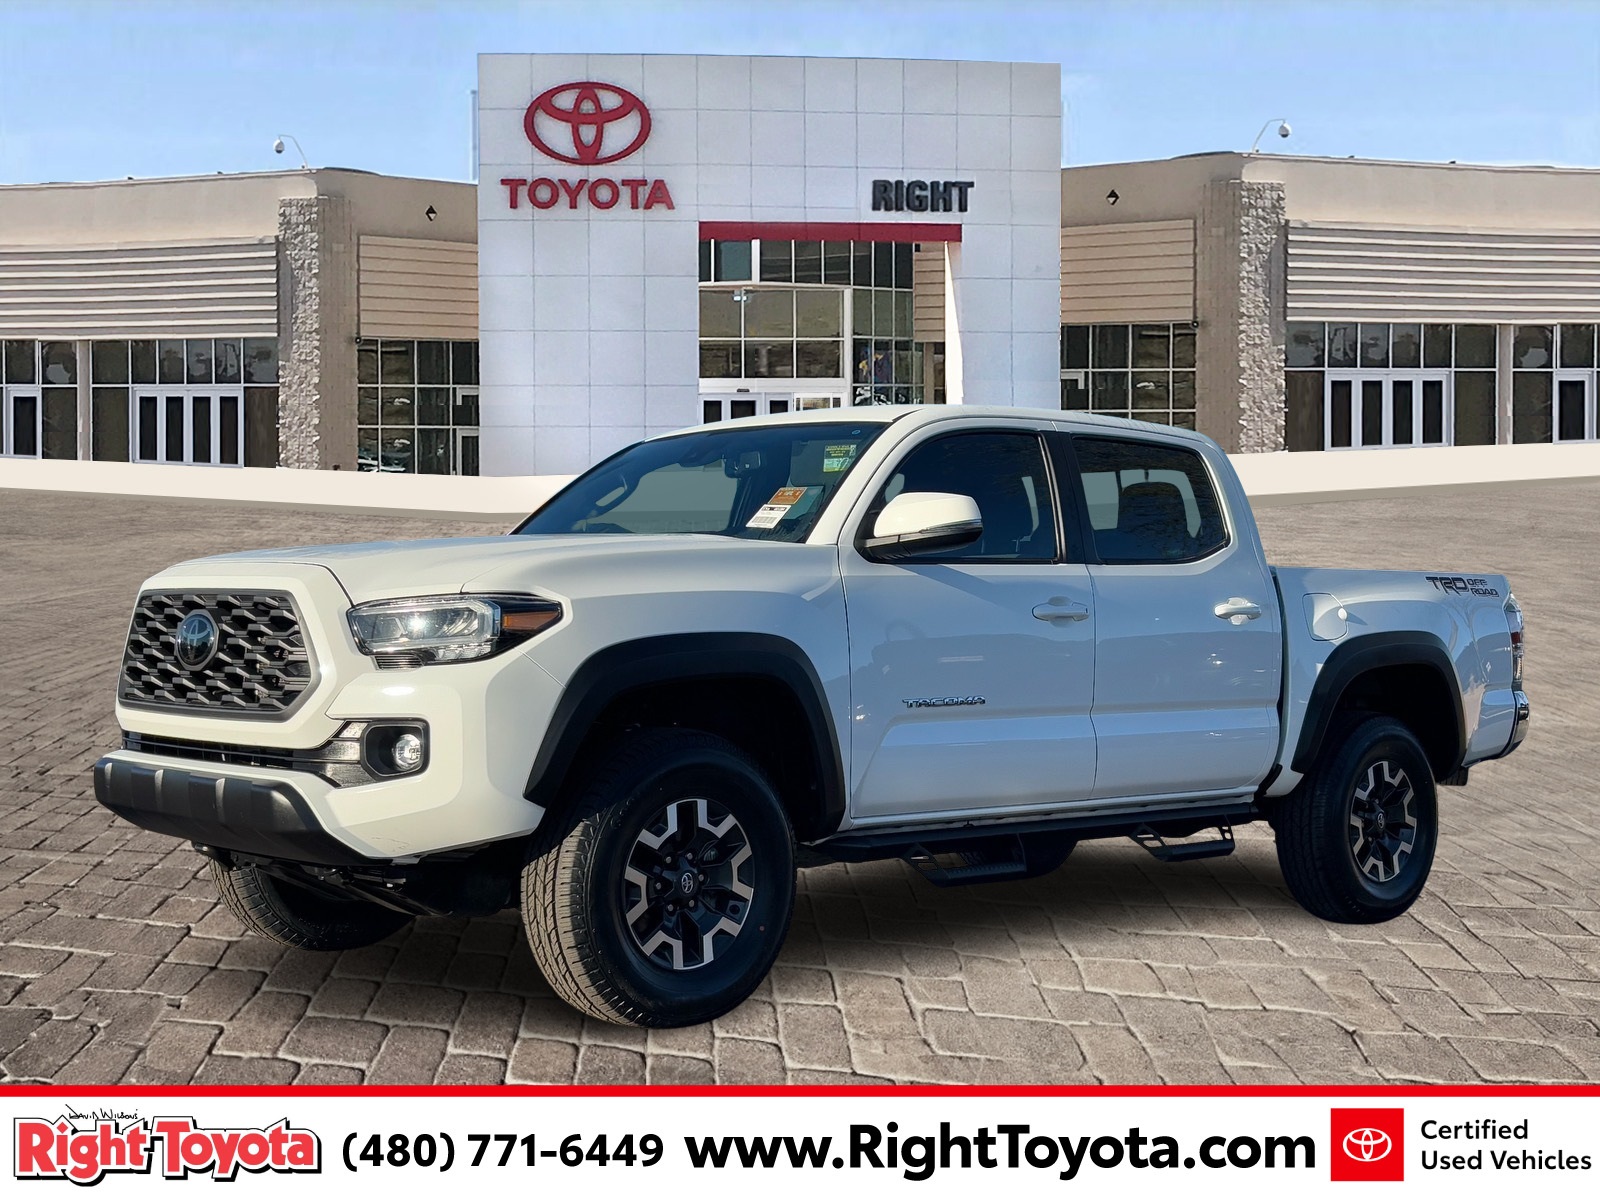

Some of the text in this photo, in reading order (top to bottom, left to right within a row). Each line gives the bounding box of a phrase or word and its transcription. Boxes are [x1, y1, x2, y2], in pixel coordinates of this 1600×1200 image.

[500, 178, 675, 210] TOYOTA
[871, 179, 975, 213] RIGHT
[1425, 576, 1487, 596] TRD OFF
[1470, 588, 1499, 597] ROAD
[902, 695, 986, 708] TACOMA
